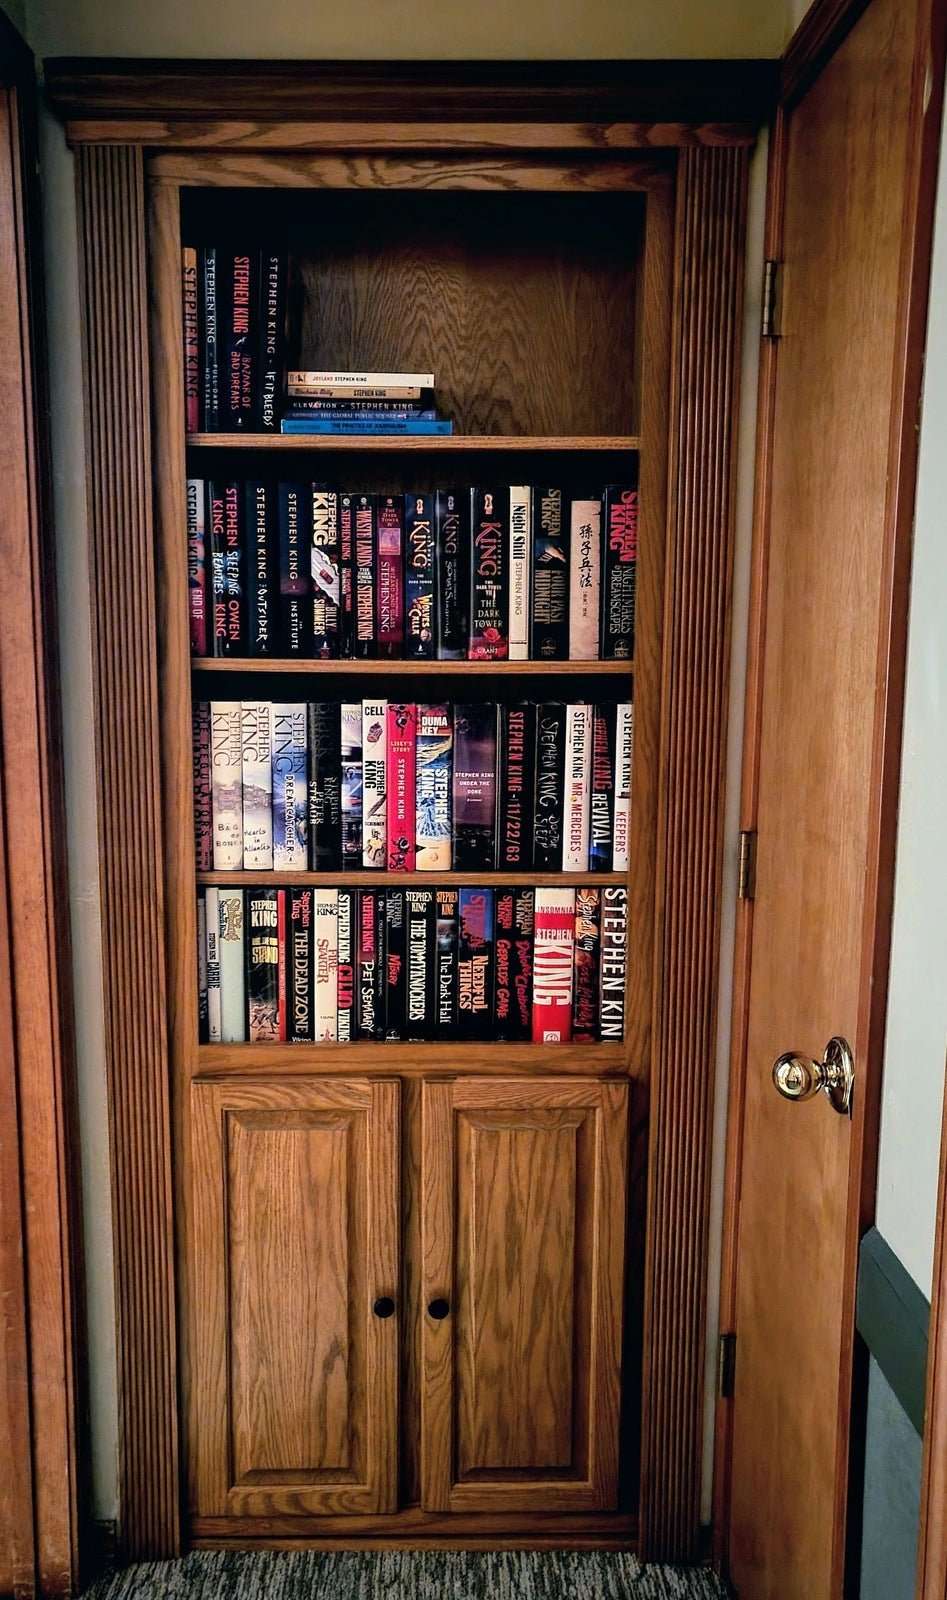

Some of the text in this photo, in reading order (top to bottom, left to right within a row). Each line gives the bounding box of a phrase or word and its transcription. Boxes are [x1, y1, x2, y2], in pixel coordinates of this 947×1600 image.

[206, 259, 215, 343] STEPHEN KING
[233, 256, 250, 334] STEPHEN KING
[266, 256, 278, 354] STEPHEN KING
[231, 351, 240, 410] BAD DREAMS
[241, 357, 252, 408] BAZAAR OF
[263, 371, 277, 426] IF IT BLEEDS
[293, 401, 336, 409] ELEVATION
[256, 487, 265, 543] STEPHEN
[312, 492, 328, 546] KING
[328, 492, 338, 546] STEPHEN
[356, 511, 372, 538] WASTE
[512, 505, 526, 534] Night
[540, 498, 551, 528] KING
[547, 488, 561, 536] STEPHEN
[610, 503, 626, 551] KING
[620, 490, 640, 561] STEPHEN
[288, 493, 298, 580] STEPHEN KING
[356, 540, 372, 568] LANDS
[442, 513, 460, 554] KING
[475, 520, 500, 576] KING
[512, 536, 526, 560] Shift
[212, 499, 227, 637] KING BEAUTIES KING
[226, 488, 240, 640] STEPHEN SLEEPING OWEN
[256, 548, 266, 580] KING
[578, 523, 594, 588] 孫子兵法
[192, 589, 203, 620] END OF
[256, 589, 268, 642] OUTSIDER
[314, 598, 326, 636] SUMMERS
[326, 606, 338, 628] BILLY
[357, 585, 374, 620] STEPHEN
[380, 561, 390, 632] STEPHEN KING
[419, 594, 433, 626] WOLVES
[478, 609, 500, 618] DARK
[480, 600, 497, 608] THE
[534, 569, 550, 624] MIDNIGHT
[552, 570, 566, 624] FOUR PAST
[610, 569, 622, 634] DREAMSCAPES
[622, 565, 636, 634] NIGHTMARES
[290, 600, 298, 648] INSTITUTE
[357, 621, 374, 640] KING
[408, 608, 422, 634] CALLA
[474, 619, 503, 628] TOWER
[364, 706, 384, 716] CELL
[422, 716, 448, 726] DUMA
[422, 726, 439, 736] KEY
[213, 712, 230, 766] KING
[229, 711, 240, 766] STEPHEN
[242, 708, 258, 762] KING
[258, 706, 270, 764] STEPHEN
[274, 714, 292, 773] KING
[292, 712, 304, 774] STEPHEN
[200, 709, 210, 836] THE REGULATORS
[365, 760, 376, 788] KING
[376, 760, 385, 796] STEPHEN
[421, 768, 434, 798] KING
[540, 718, 560, 807] STEPHEN KING
[570, 712, 585, 852] STEPHEN KING MERCEDES
[434, 768, 448, 823] STEPHEN
[506, 711, 524, 862] STEPHEN KING 11/22/63
[592, 756, 612, 848] KING REVIVAL
[218, 824, 239, 832] BAG
[286, 774, 294, 852] DREAMCATCHER
[316, 792, 324, 825] PETER
[534, 814, 548, 848] SLEEP
[548, 816, 560, 848] DOCTOR
[616, 811, 626, 852] KEEPERS
[250, 900, 278, 910] STEPHEN
[292, 900, 301, 920] King
[301, 891, 311, 928] Stephen
[338, 894, 350, 938] STEPHEN
[386, 899, 395, 922] KING
[392, 892, 402, 928] STEPHEN
[405, 892, 432, 902] STEPHEN
[502, 895, 513, 928] STEPHEN
[520, 890, 534, 935] STEPHEN
[538, 906, 574, 914] INSOMNIA
[577, 895, 598, 931] Stephen
[252, 910, 278, 928] KING
[536, 928, 575, 940] STEPHEN
[252, 946, 278, 964] STAND
[294, 930, 308, 958] THE
[317, 938, 328, 984] STARTER
[338, 940, 350, 963] KING
[576, 931, 599, 951] King
[207, 962, 220, 989] CARRIE
[294, 958, 308, 995] DEAD
[360, 895, 374, 1032] STEPHEN KING PET SEMATARY
[409, 918, 426, 1020] THE TOMMYKNOCKERS
[533, 944, 573, 1006] KING
[601, 888, 628, 1042] STEPHEN KIN
[440, 952, 452, 1024] The Dark Half
[459, 960, 472, 1010] THINGS
[472, 955, 488, 1014] NEEDFUL
[496, 988, 511, 1019] GAME
[294, 996, 308, 1034] ZONE
[338, 1008, 350, 1041] VIKING
